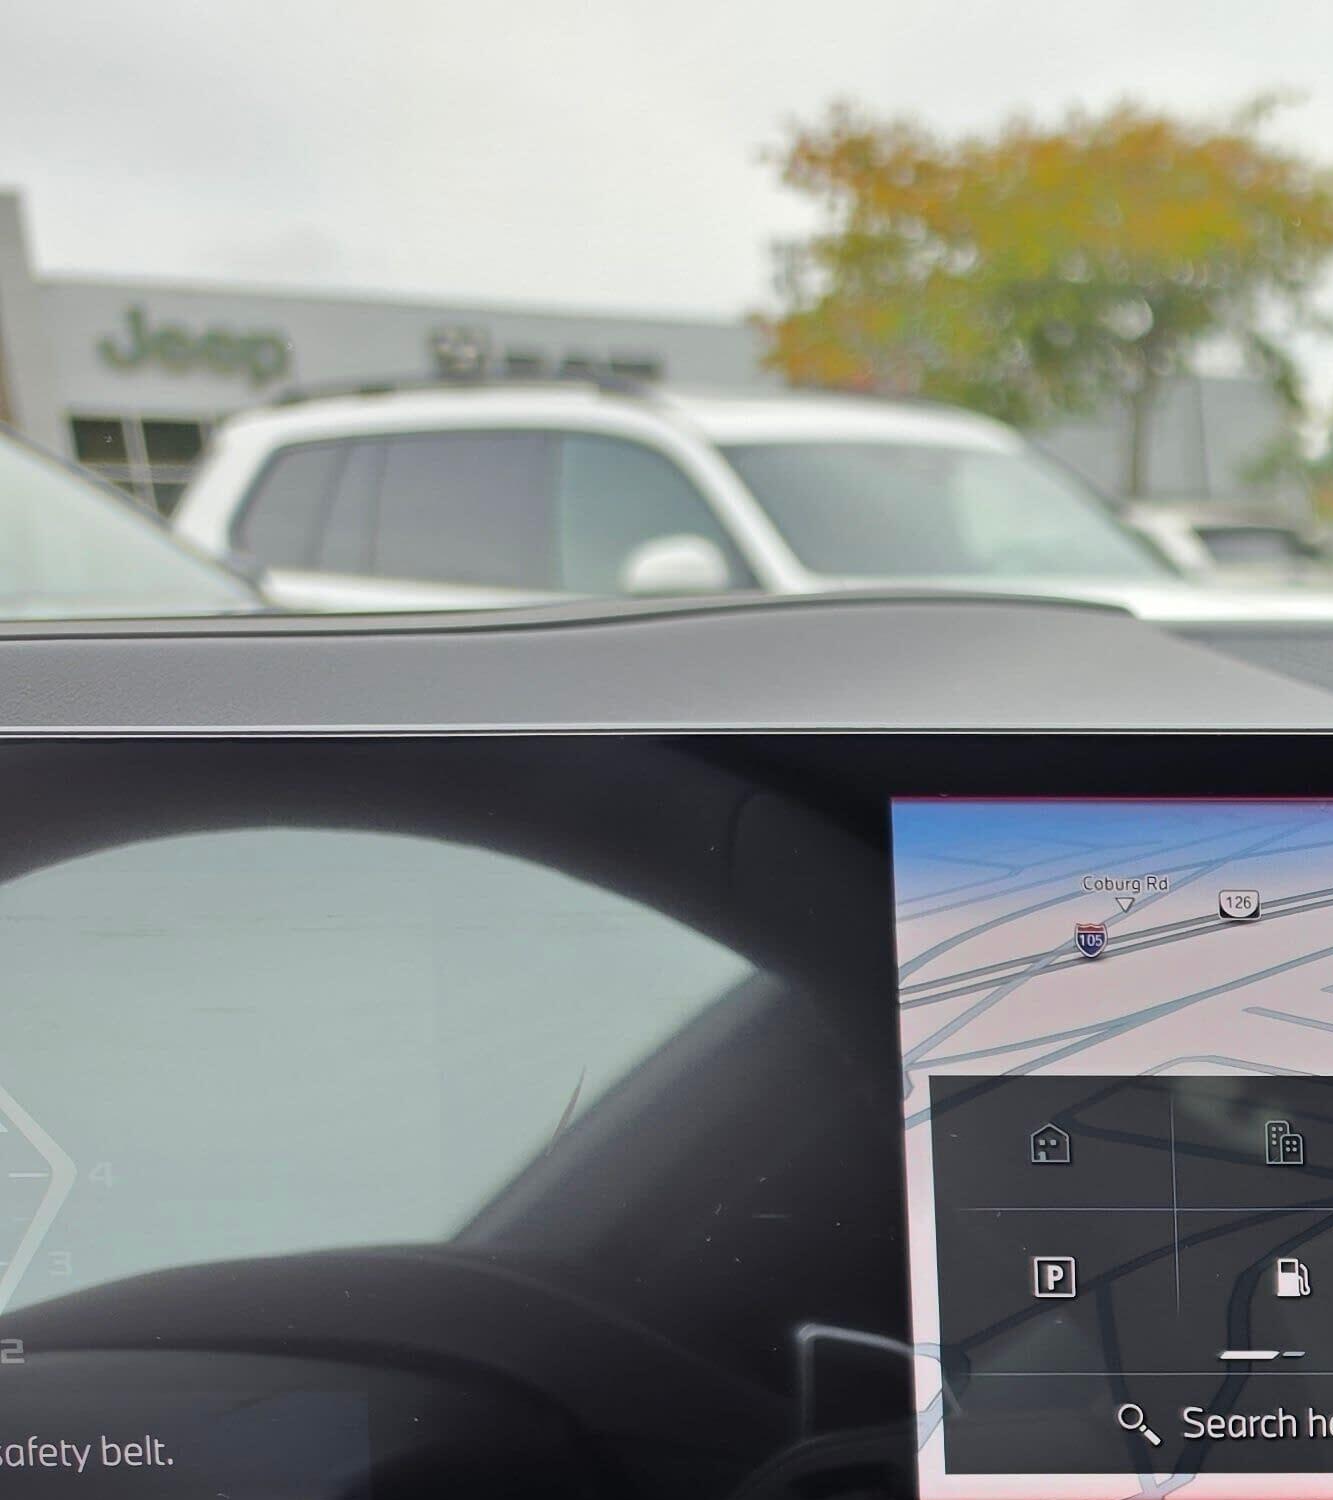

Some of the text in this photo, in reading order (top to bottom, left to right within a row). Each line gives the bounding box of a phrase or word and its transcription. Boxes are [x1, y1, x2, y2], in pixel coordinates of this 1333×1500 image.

[100, 305, 292, 384] Jeep
[1083, 875, 1169, 893] Coburg Rd
[1226, 896, 1251, 910] 126
[1079, 934, 1103, 948] 105
[1183, 1407, 1298, 1440] Search
[101, 1434, 174, 1467] belt.
